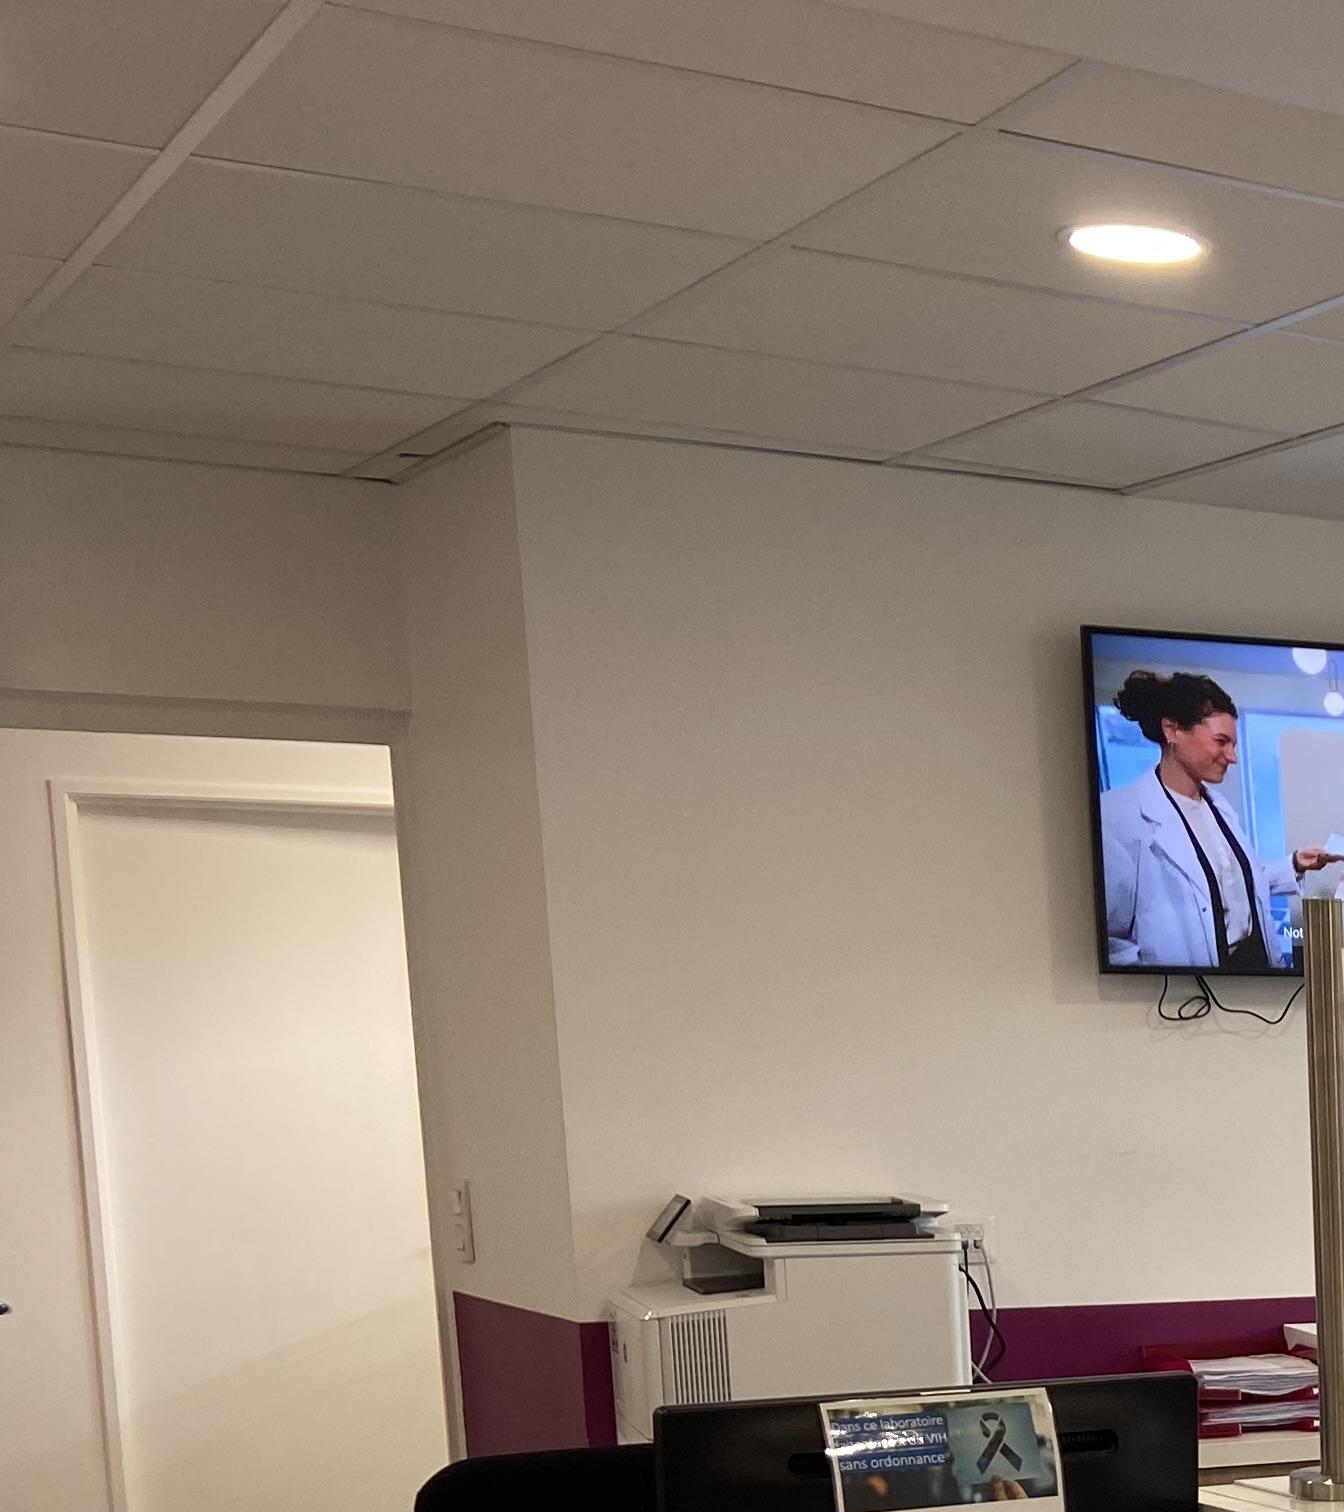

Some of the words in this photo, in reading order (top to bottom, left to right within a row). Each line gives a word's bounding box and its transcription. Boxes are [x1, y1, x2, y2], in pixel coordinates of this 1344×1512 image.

[864, 1421, 878, 1431] ce
[880, 1416, 944, 1430] laboratoire
[839, 1460, 868, 1471] sans
[871, 1453, 946, 1469] ordonnance
